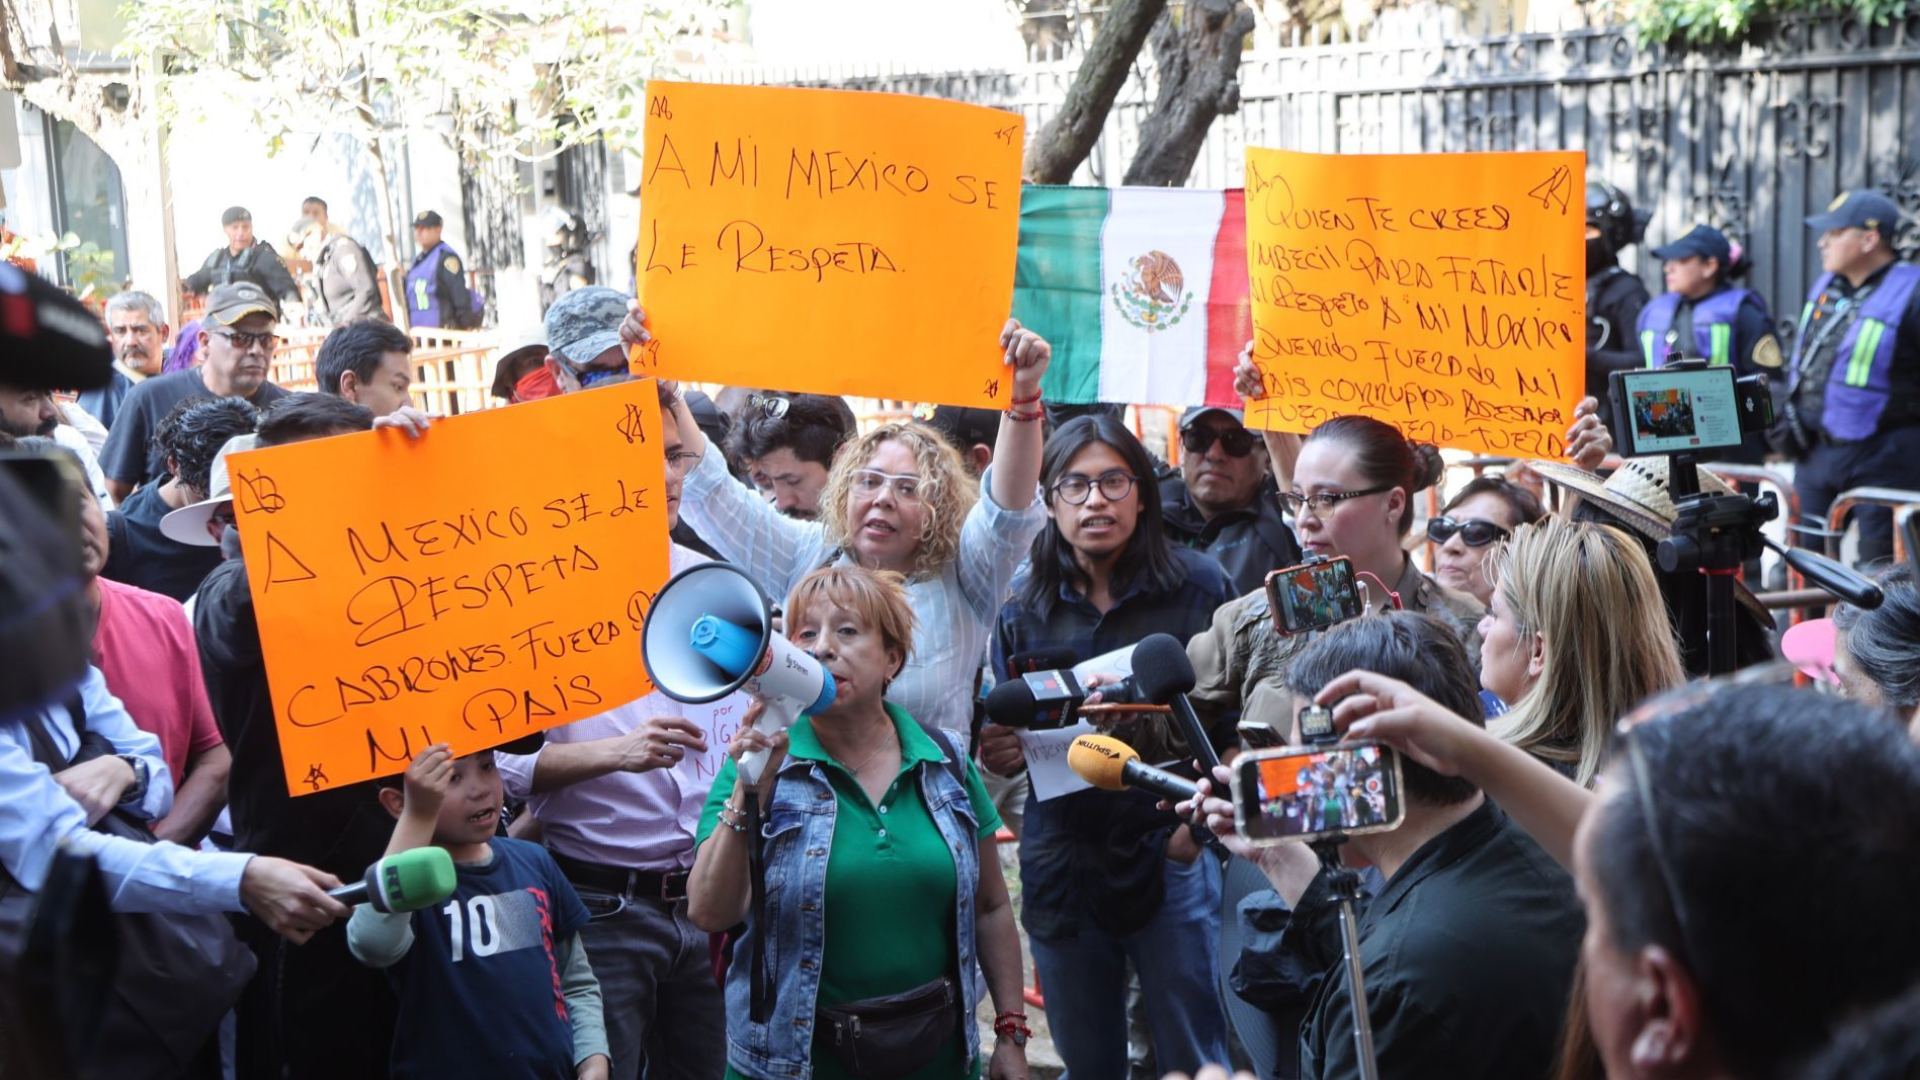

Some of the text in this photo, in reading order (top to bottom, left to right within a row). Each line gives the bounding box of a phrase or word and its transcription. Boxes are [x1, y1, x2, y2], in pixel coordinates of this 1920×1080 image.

[647, 133, 691, 190] A
[948, 175, 999, 210] SE
[1265, 175, 1355, 232] QUIEN
[1346, 197, 1399, 232] TE
[645, 219, 698, 275] LE
[264, 530, 317, 594] A
[543, 493, 602, 528] SE
[610, 480, 649, 518] LE
[346, 544, 599, 648] RESPETA
[511, 620, 620, 670] FUERA
[713, 705, 733, 728] por
[442, 895, 501, 962] 10
